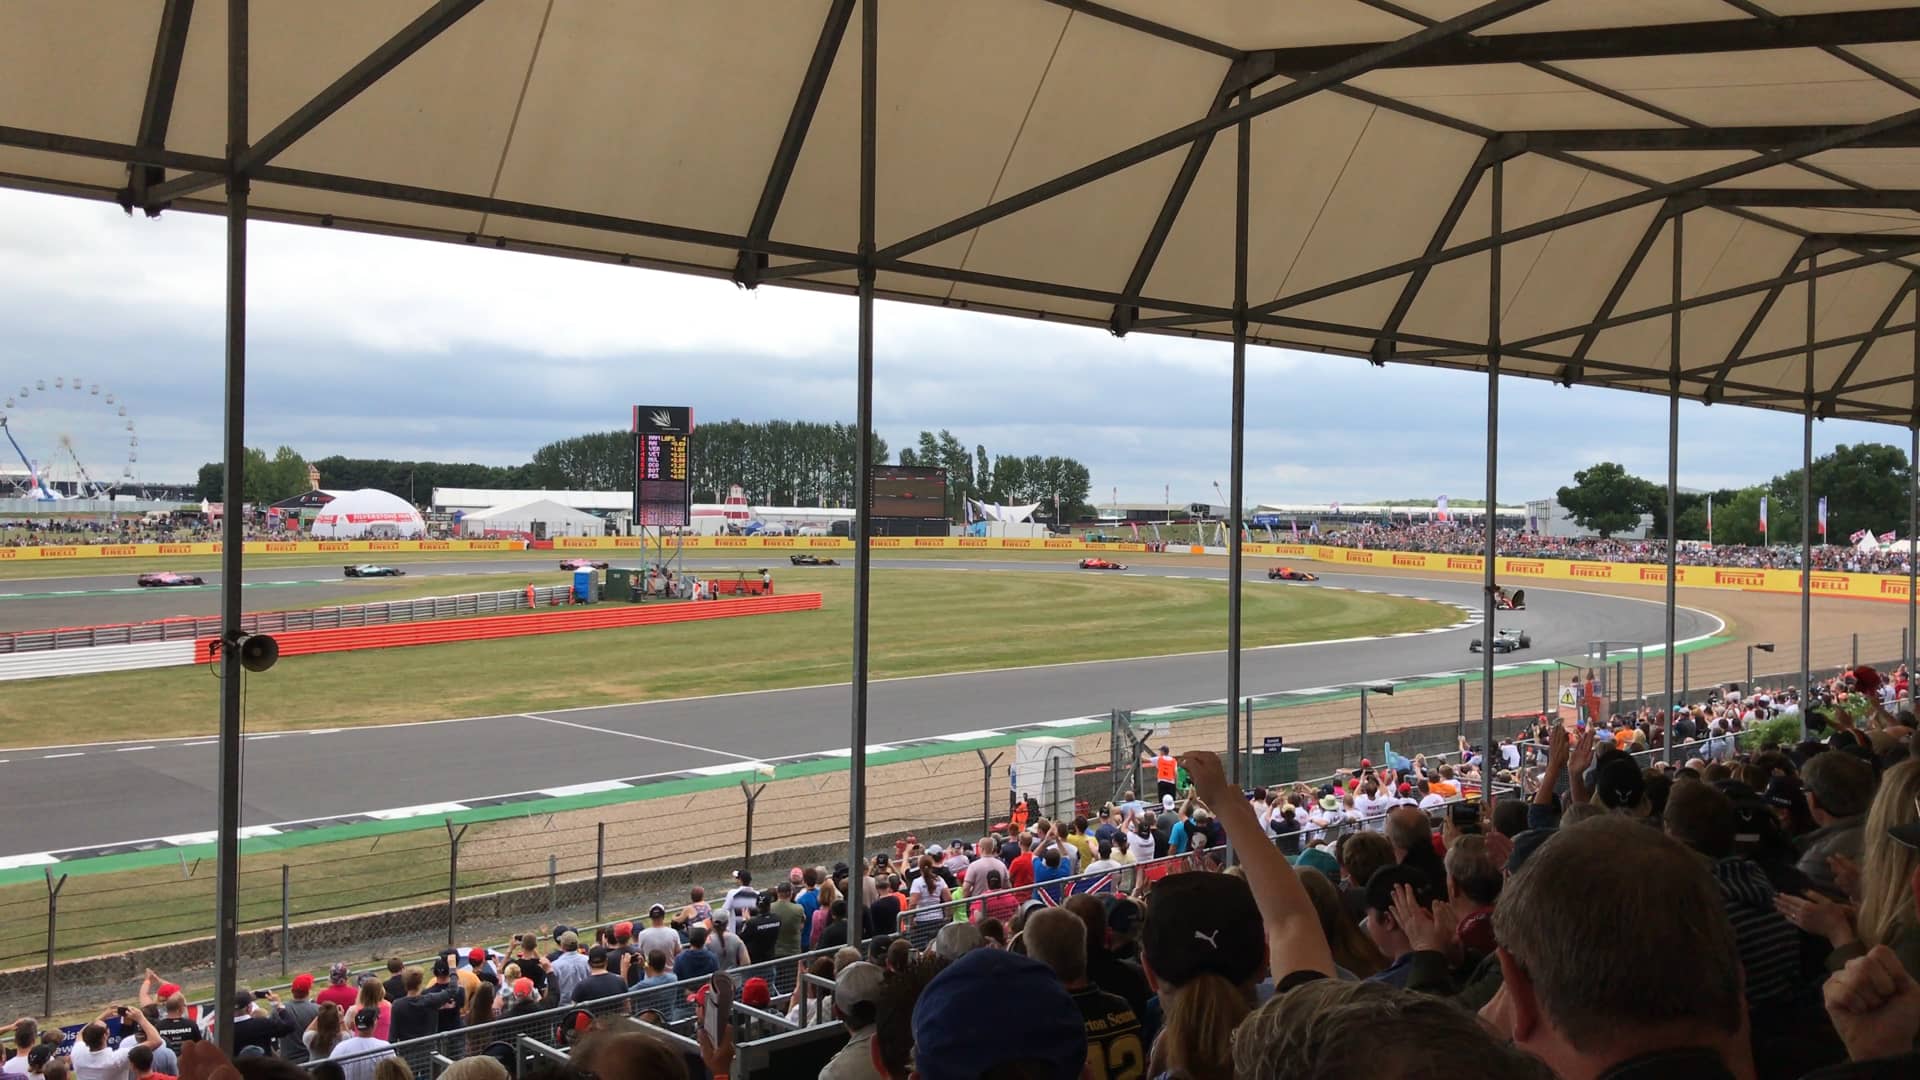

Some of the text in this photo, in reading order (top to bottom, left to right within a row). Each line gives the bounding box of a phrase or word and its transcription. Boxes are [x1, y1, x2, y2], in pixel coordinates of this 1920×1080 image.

[615, 538, 649, 547] PIRELI
[1346, 551, 1373, 563] PIRELLI
[1392, 554, 1425, 567] PIRELLI
[1447, 558, 1483, 570] PIRELLI
[1506, 561, 1544, 574] PIRELLI
[1570, 564, 1612, 577] PIRELLI
[1640, 567, 1684, 582] PIRELI
[1715, 571, 1764, 586] PIRELLI
[1799, 574, 1849, 590] PRELLI
